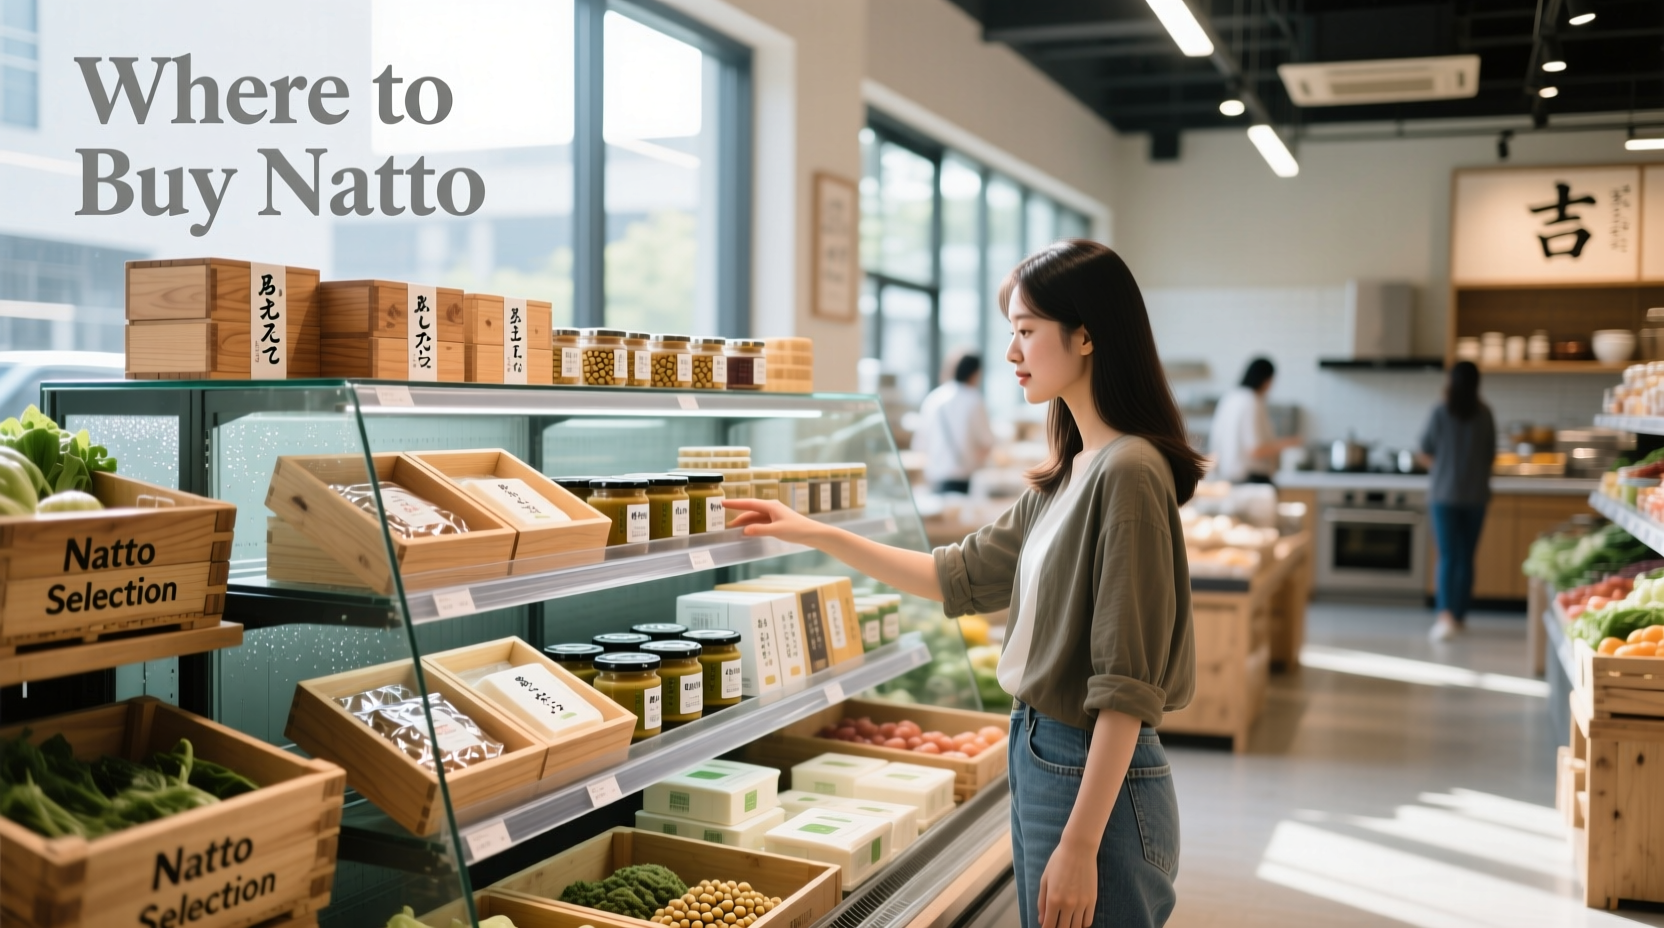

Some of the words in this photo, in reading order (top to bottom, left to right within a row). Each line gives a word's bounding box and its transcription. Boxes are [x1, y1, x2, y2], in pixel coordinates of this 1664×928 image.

[1529, 181, 1597, 260] 吉
[63, 536, 156, 573] Natto
[45, 576, 177, 616] Selection
[151, 837, 253, 892] Natto
[138, 872, 276, 928] Selection
